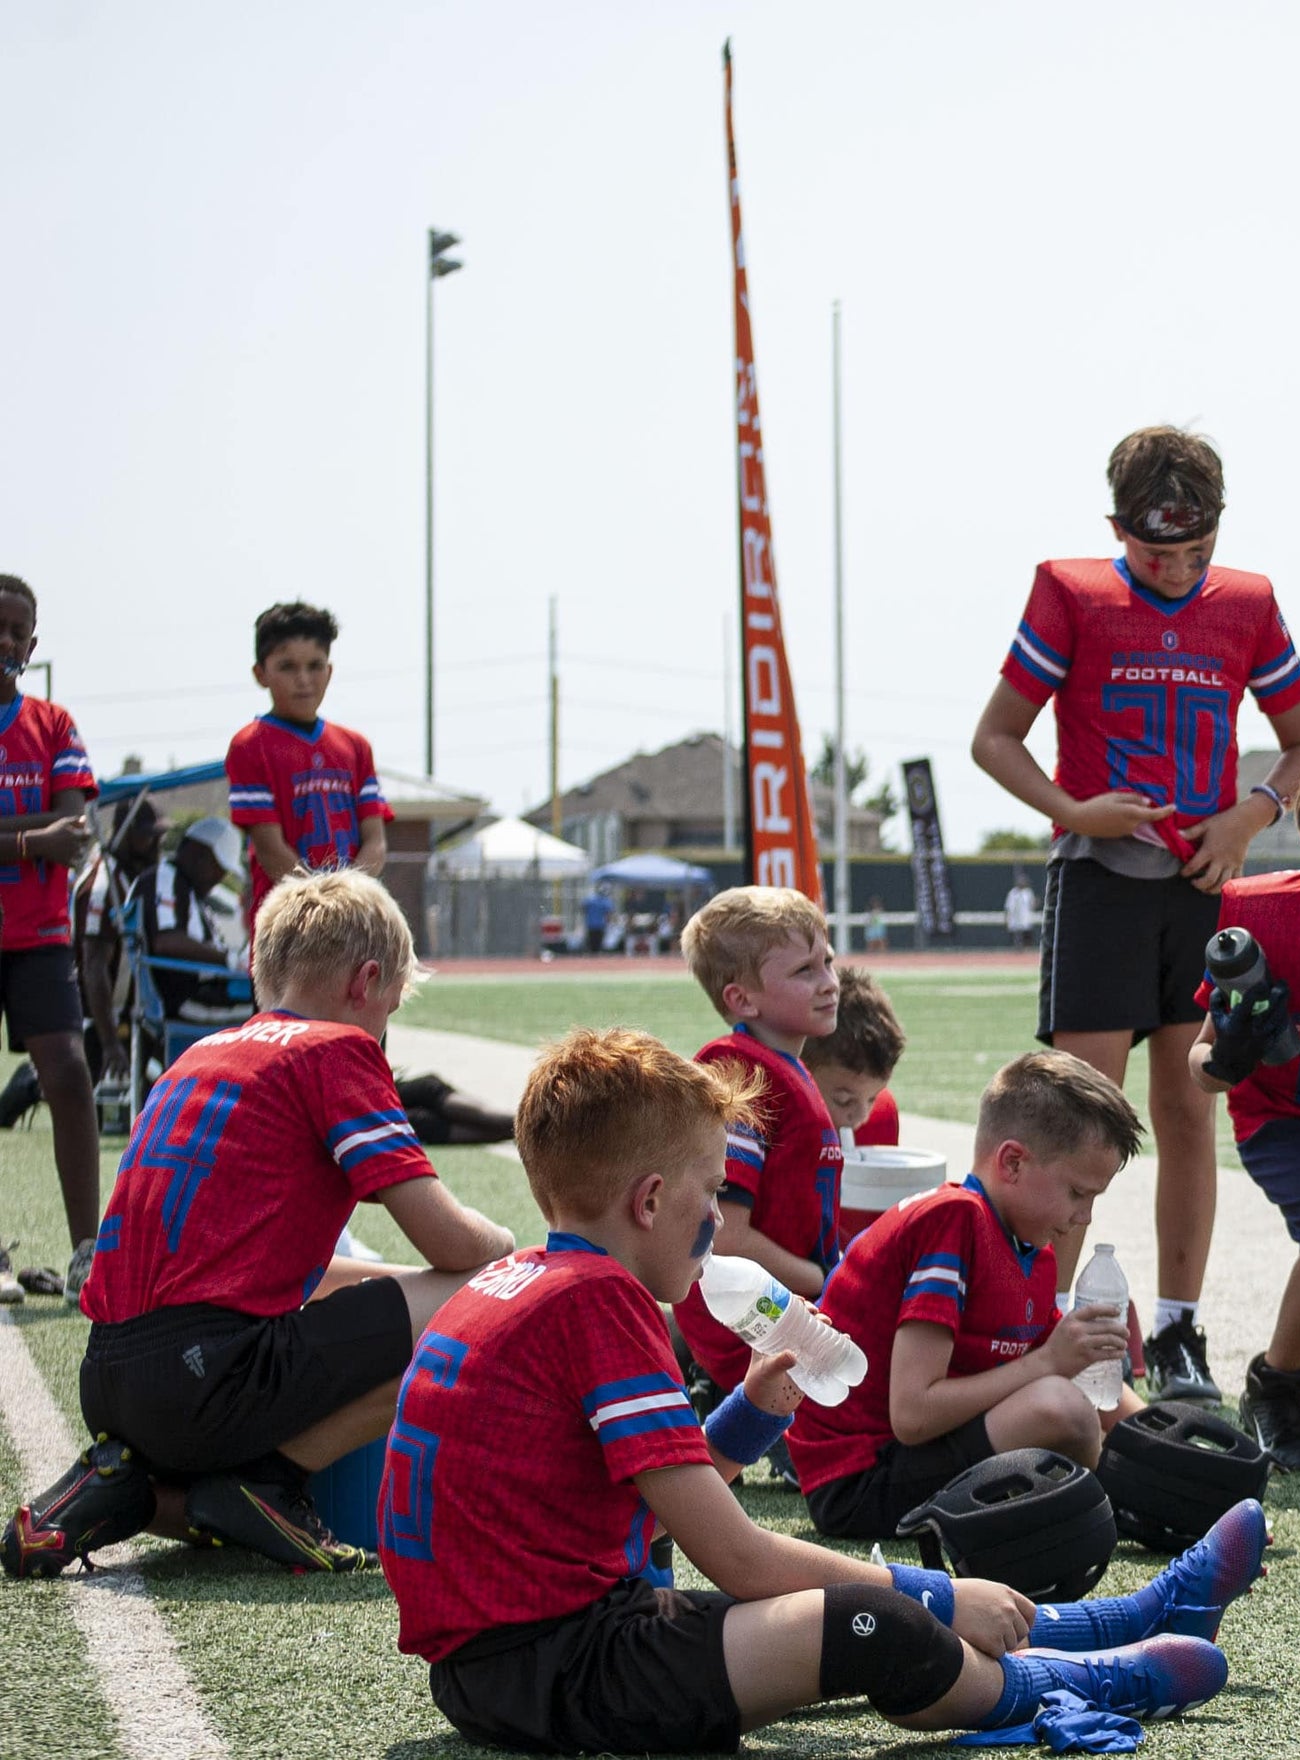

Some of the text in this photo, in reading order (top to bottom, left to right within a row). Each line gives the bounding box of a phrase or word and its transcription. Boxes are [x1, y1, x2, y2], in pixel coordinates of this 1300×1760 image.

[1110, 651, 1224, 673] GRIDIRON
[1110, 667, 1223, 686] FOOTBALL
[1101, 683, 1230, 816] 20
